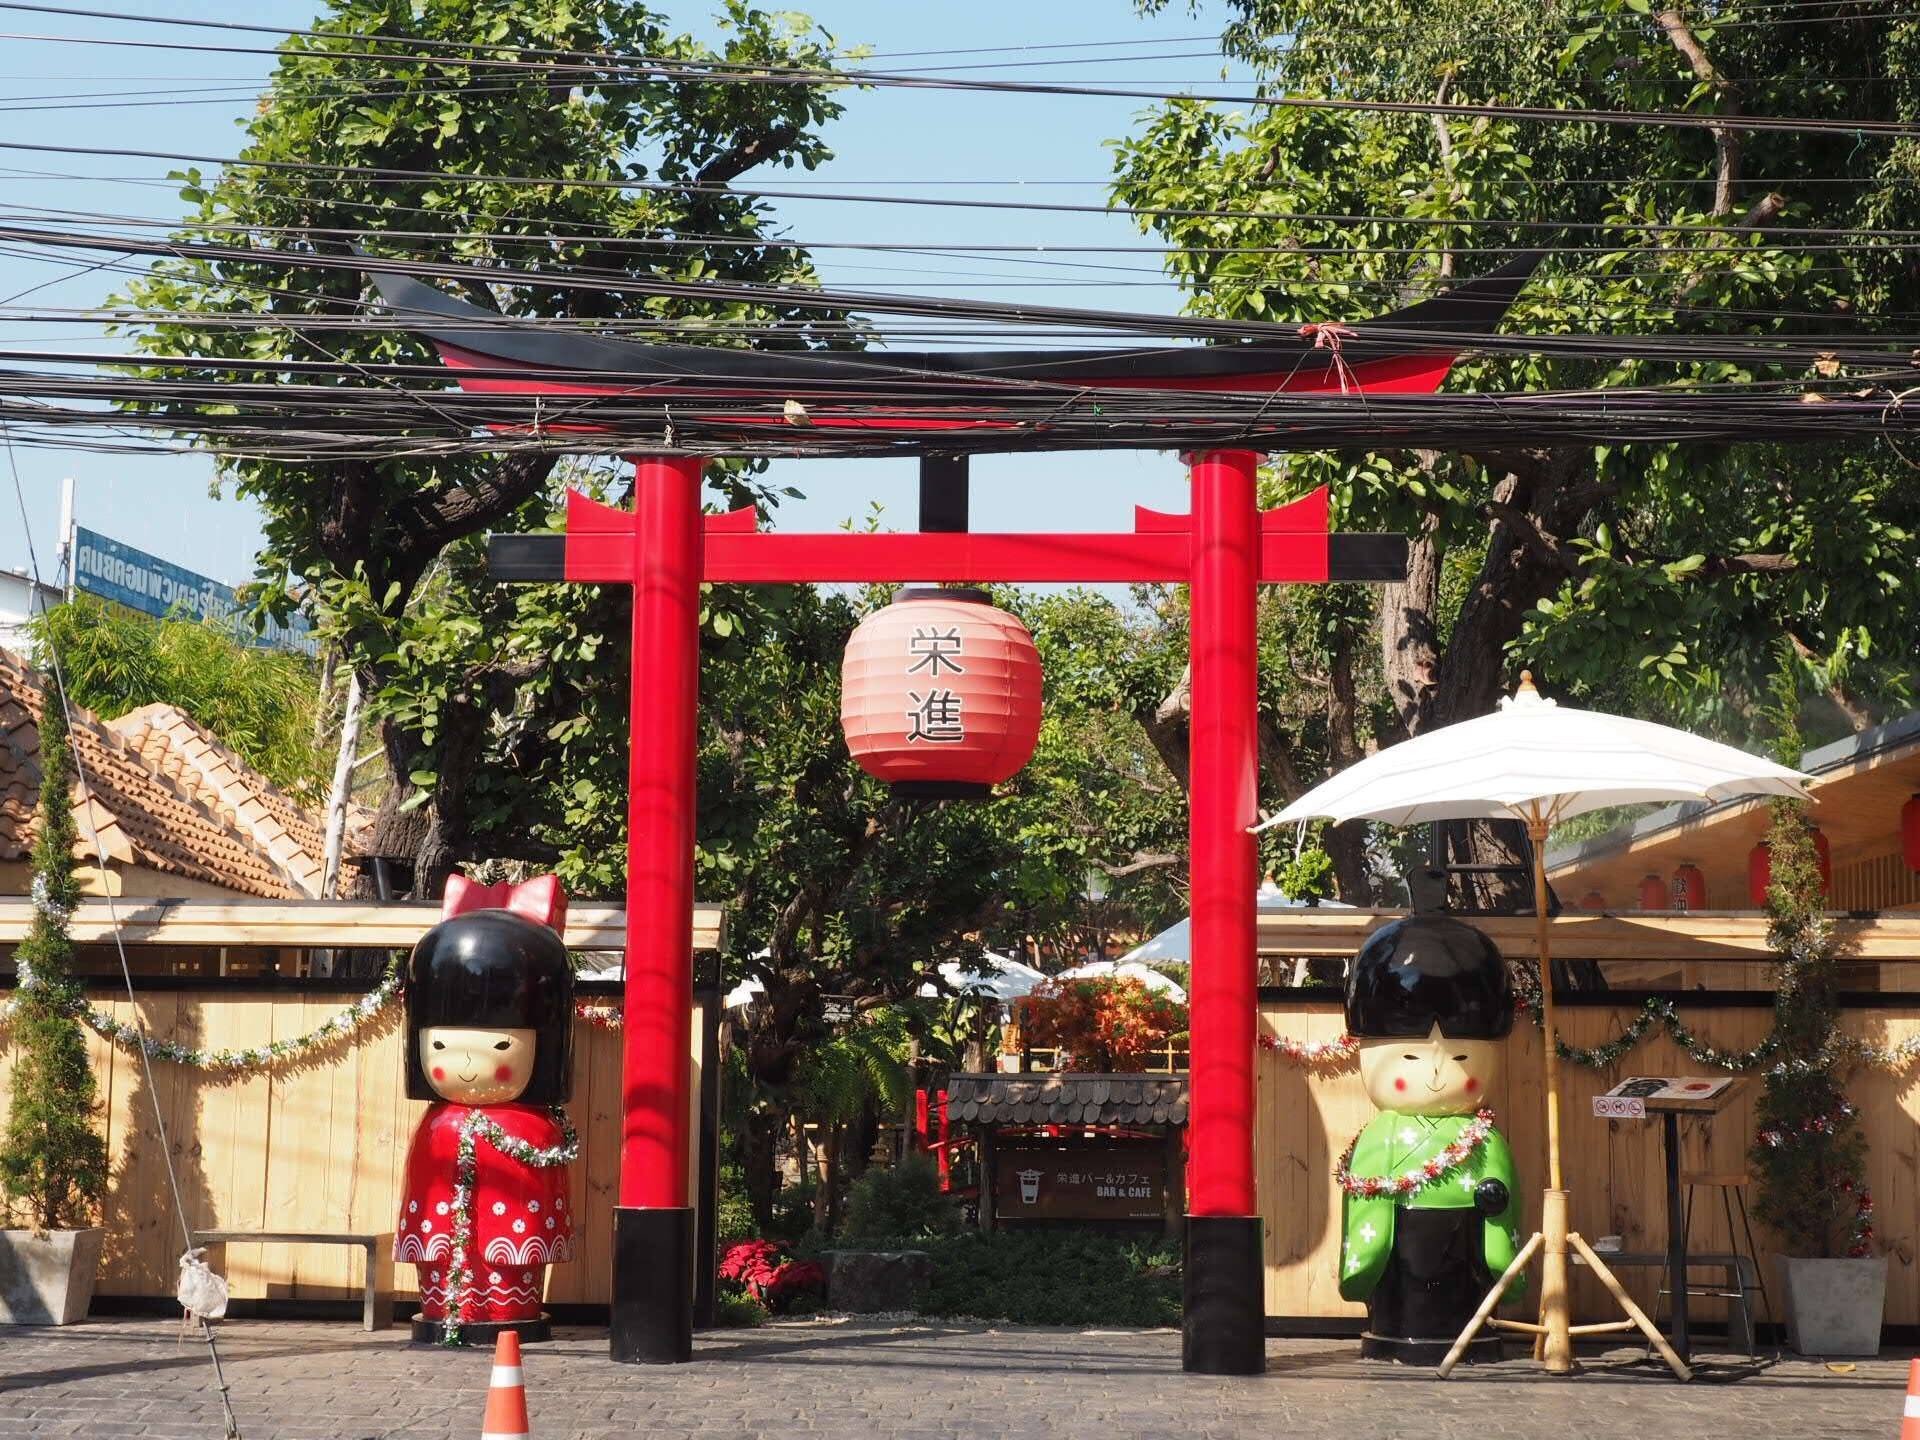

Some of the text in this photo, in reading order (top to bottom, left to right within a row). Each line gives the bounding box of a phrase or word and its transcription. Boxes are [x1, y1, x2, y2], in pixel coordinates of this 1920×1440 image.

[906, 626, 966, 742] 栄進
[1096, 1186, 1152, 1199] BAR & CAFE
